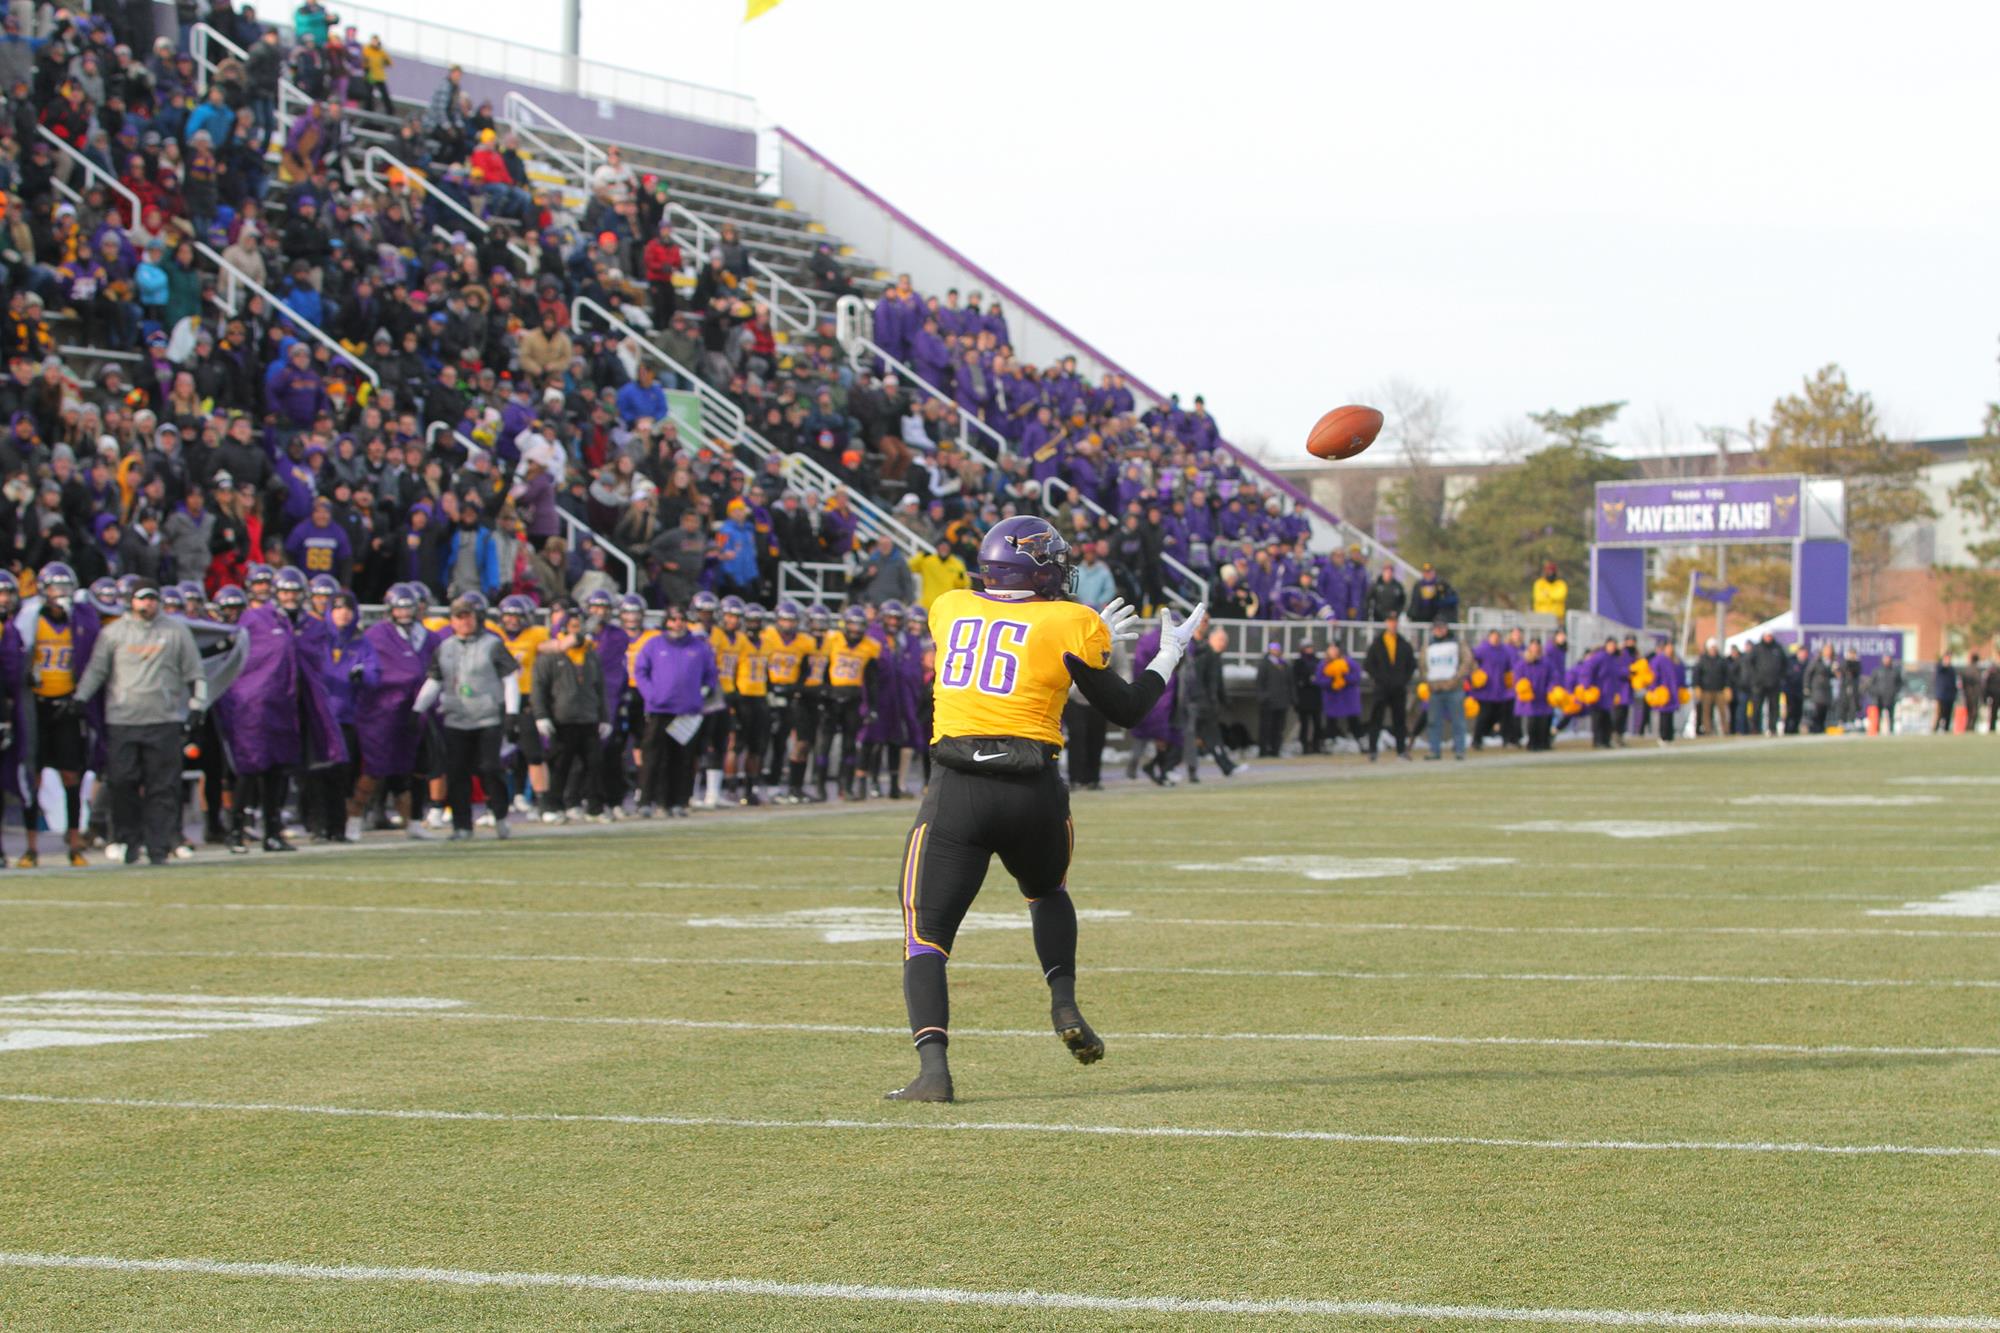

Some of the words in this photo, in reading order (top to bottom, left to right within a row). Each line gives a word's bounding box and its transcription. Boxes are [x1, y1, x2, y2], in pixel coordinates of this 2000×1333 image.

[1626, 504, 1714, 533] MAVERICK
[1718, 502, 1771, 531] FANS!
[942, 616, 1034, 697] 86
